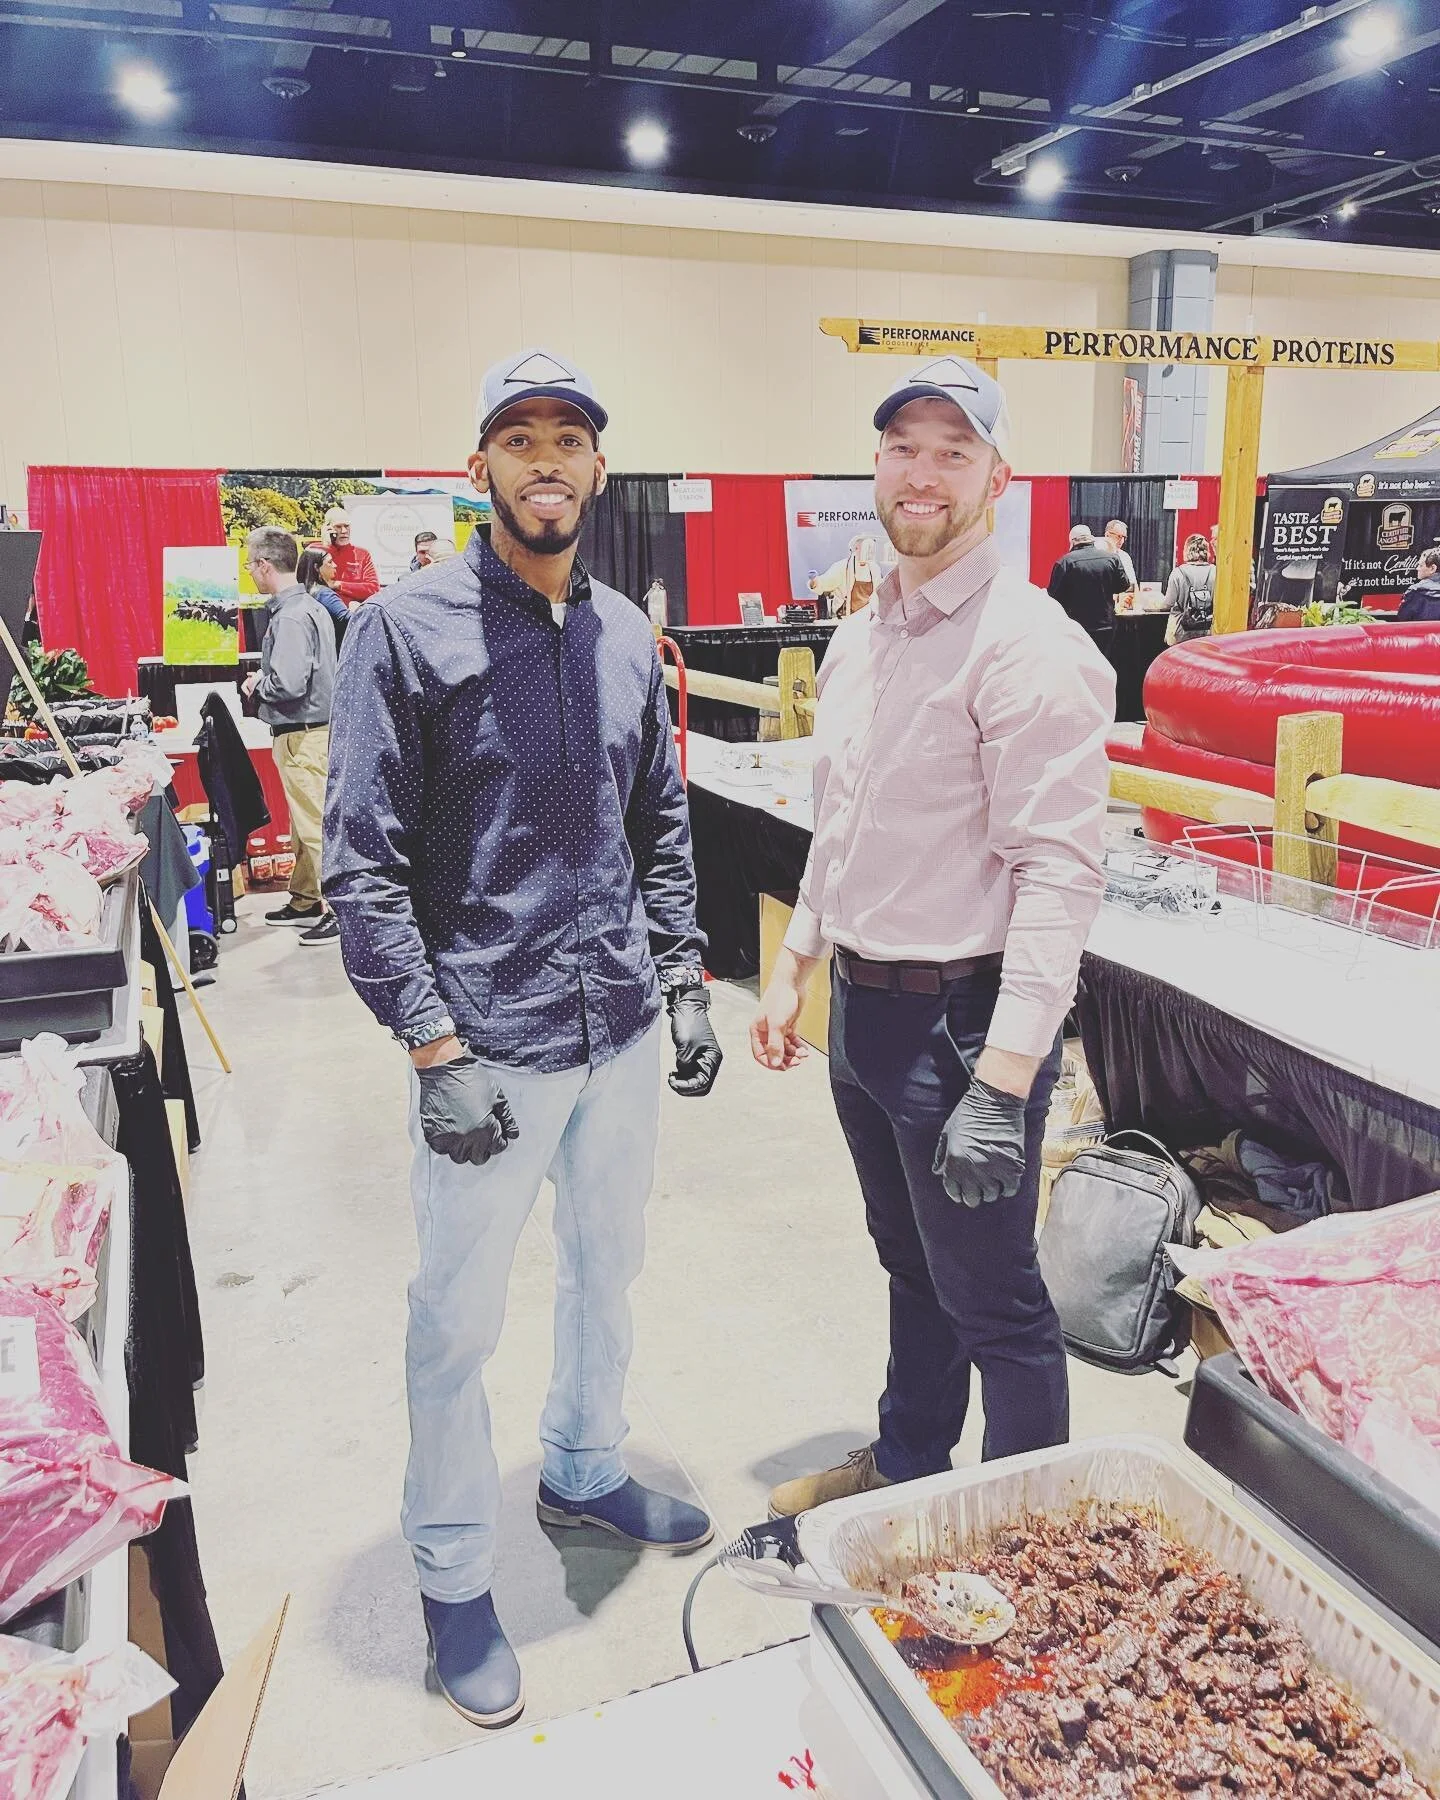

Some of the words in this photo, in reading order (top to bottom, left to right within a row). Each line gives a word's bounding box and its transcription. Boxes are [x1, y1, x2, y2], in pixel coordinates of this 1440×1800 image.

[882, 327, 975, 342] PERFORMANCE
[1044, 331, 1258, 361] PERFORMANCE
[1271, 339, 1395, 365] PROTEINS
[1273, 512, 1310, 525] TASTE
[1272, 525, 1338, 545] BEST
[1353, 560, 1365, 570] it's
[1366, 560, 1381, 570] not
[1364, 577, 1379, 586] not
[1380, 575, 1394, 586] the
